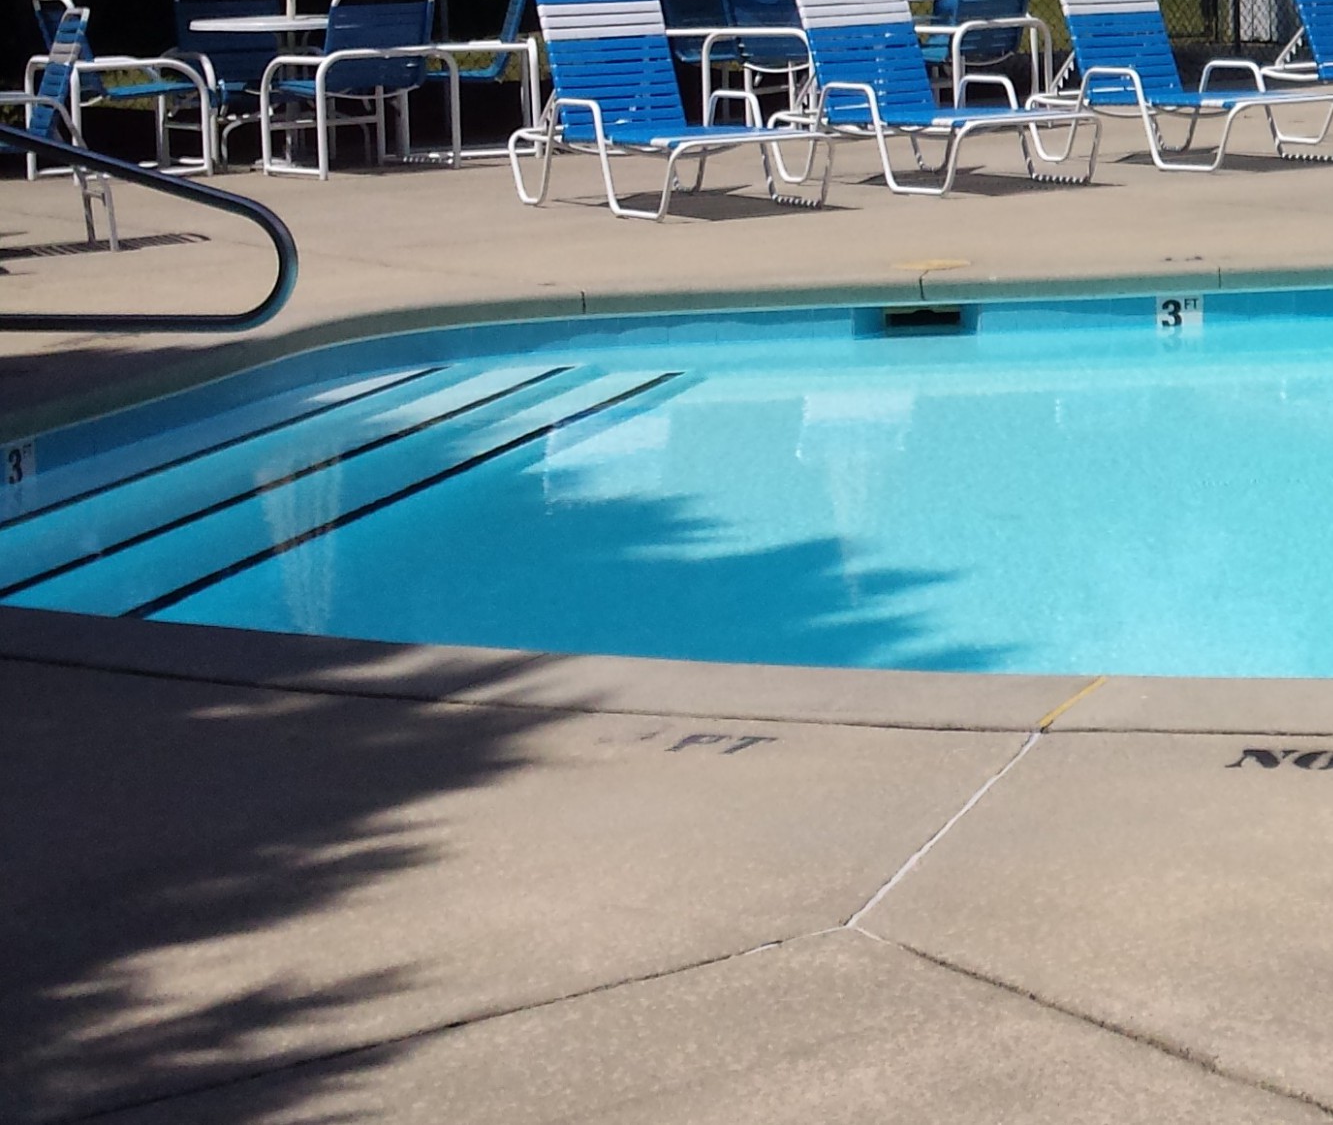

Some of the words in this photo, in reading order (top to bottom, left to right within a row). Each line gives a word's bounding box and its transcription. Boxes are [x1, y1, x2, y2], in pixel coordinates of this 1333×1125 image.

[1161, 299, 1183, 327] 3
[1184, 298, 1199, 310] FT
[9, 449, 23, 485] 3
